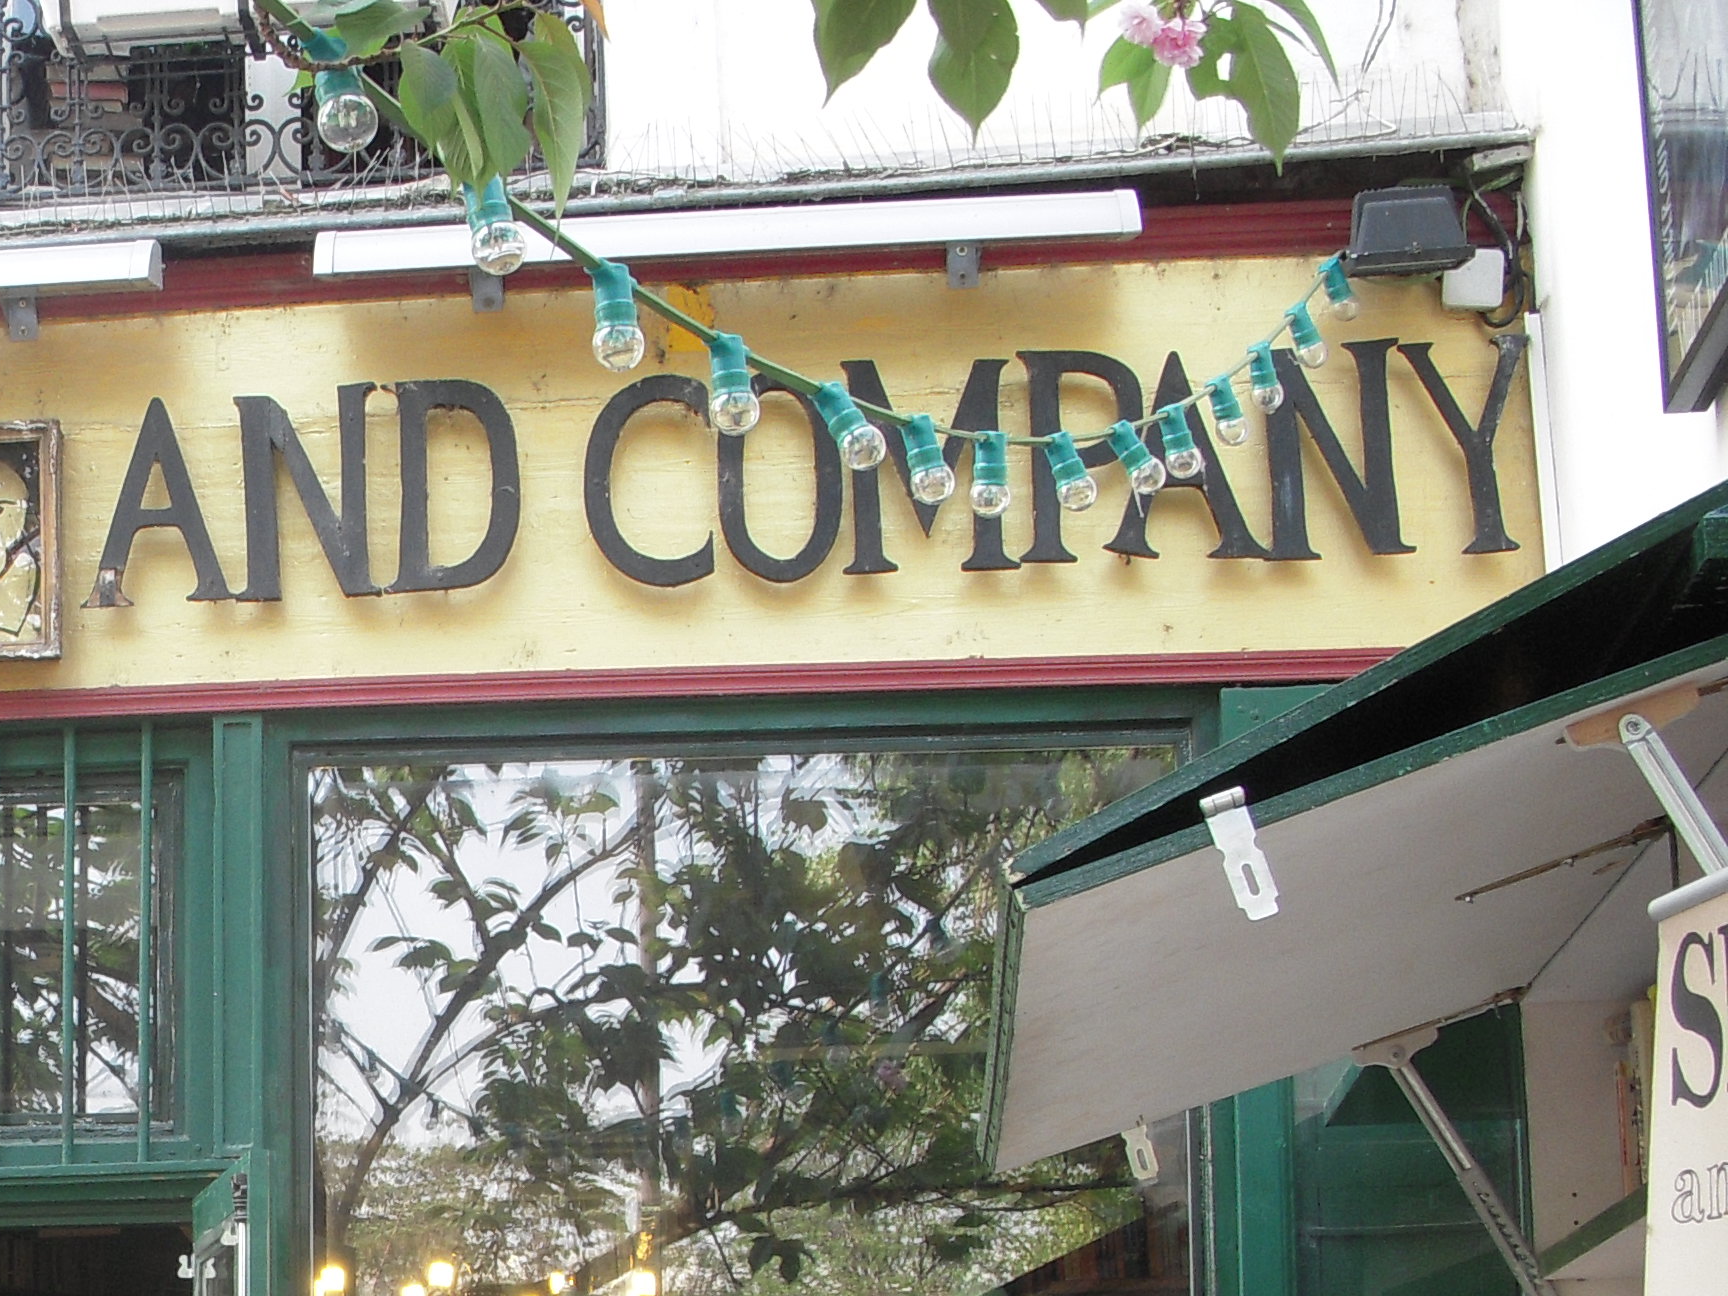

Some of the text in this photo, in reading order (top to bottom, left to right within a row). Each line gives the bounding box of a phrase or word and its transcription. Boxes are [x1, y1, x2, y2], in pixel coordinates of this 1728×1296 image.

[81, 379, 522, 608] AND
[583, 334, 1526, 589] COMPANY
[1671, 924, 1728, 1108] S
